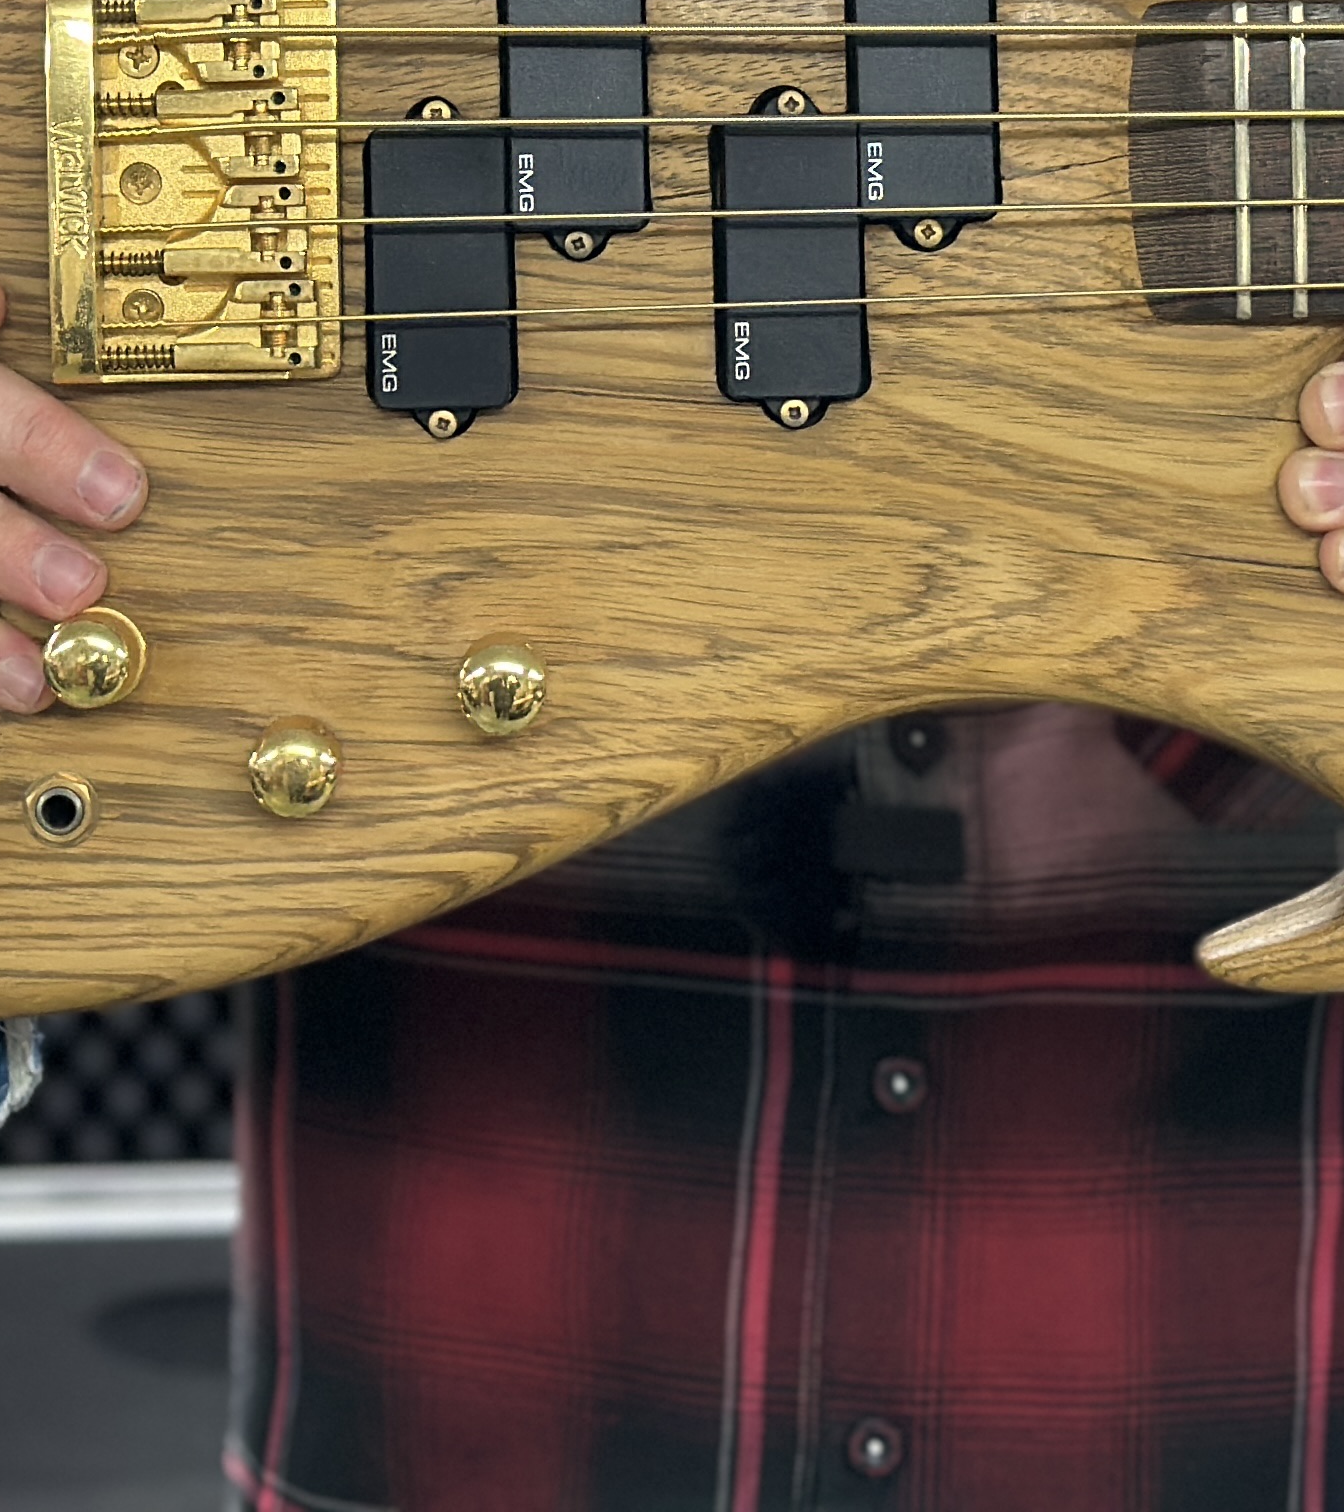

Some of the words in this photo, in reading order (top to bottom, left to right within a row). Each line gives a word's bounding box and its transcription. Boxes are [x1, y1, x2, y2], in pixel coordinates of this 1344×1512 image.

[50, 116, 90, 260] Warwick
[518, 153, 534, 213] EMG
[867, 141, 883, 201] EMG
[381, 333, 397, 393] EMG
[734, 321, 750, 381] EMG
